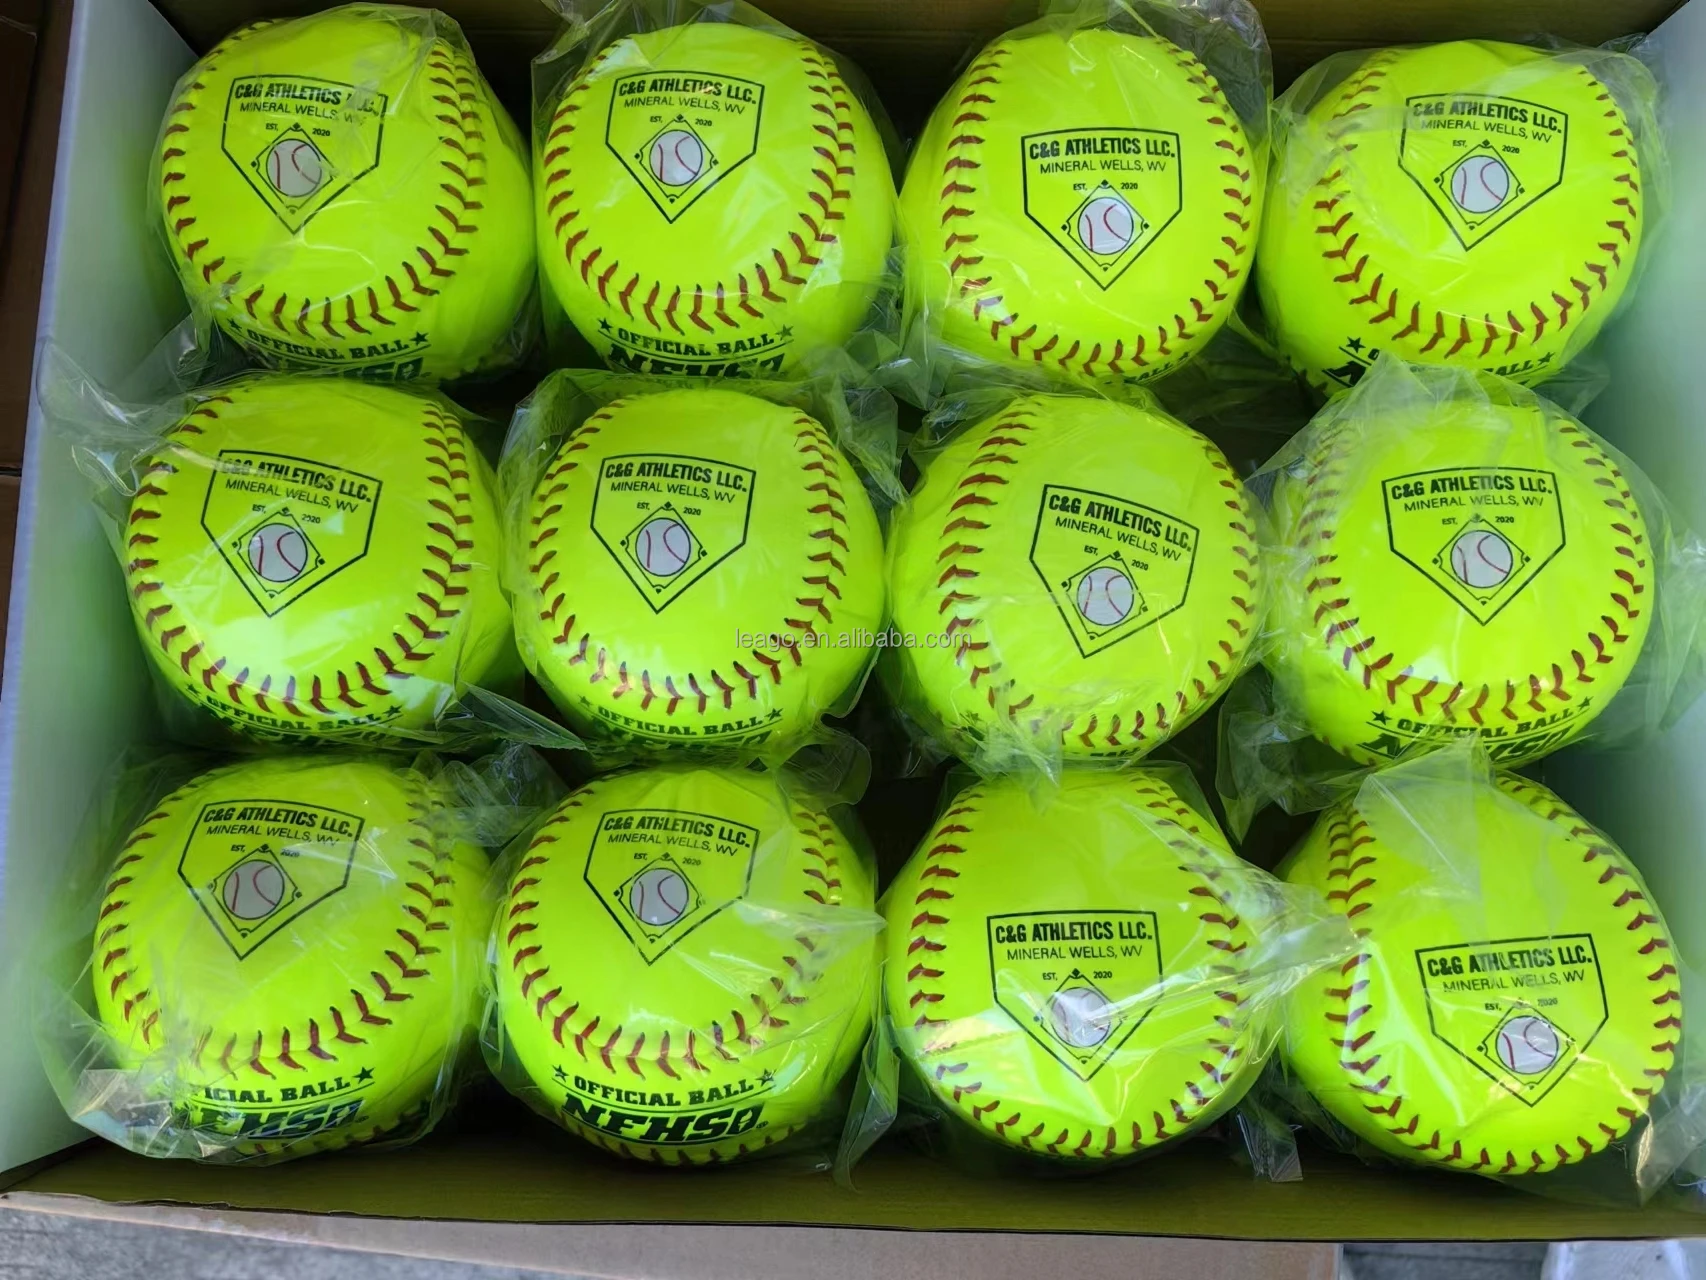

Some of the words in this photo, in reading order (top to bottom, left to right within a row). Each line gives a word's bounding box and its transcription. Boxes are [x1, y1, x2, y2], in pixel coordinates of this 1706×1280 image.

[235, 84, 263, 98] C&G
[265, 83, 341, 105] ATHLETICS
[619, 80, 646, 96] C&G
[649, 79, 722, 96] ATHLETICS
[727, 85, 757, 104] LLC.
[240, 102, 290, 114] MINERAL
[295, 105, 339, 120] WELLS
[624, 96, 675, 108] MINERAL
[679, 97, 721, 112] WELLS,
[725, 103, 745, 115] WV
[695, 119, 713, 127] 2020
[1413, 102, 1446, 117] C&G
[1449, 101, 1528, 123] ATHLETICS
[1533, 111, 1562, 134] LLC.
[312, 128, 331, 136] 2020
[1421, 119, 1480, 131] MINERAL
[1484, 121, 1528, 140] WELLS,
[1532, 129, 1552, 143] WV
[1030, 140, 1060, 160] C&G
[1065, 138, 1141, 156] ATHLETICS
[1146, 139, 1175, 158] LLC.
[1502, 145, 1520, 154] 2020
[1040, 160, 1097, 174] MINERAL
[1100, 159, 1144, 172] WELLS,
[1147, 161, 1167, 172] WV
[1121, 182, 1138, 190] 2020
[348, 339, 410, 359] BALL
[618, 328, 711, 356] OFFICIAL
[716, 333, 775, 354] BALL
[606, 462, 634, 478] C&G
[636, 462, 712, 483] ATHLETICS
[716, 471, 747, 492] LLC.
[1391, 481, 1425, 500] C&G
[1430, 475, 1515, 494] ATHLETICS
[1519, 476, 1553, 494] LLC.
[225, 479, 282, 497] MINERAL
[286, 488, 331, 509] WELLS,
[336, 499, 359, 513] WV
[339, 479, 372, 503] LLC.
[610, 481, 663, 492] MINERAL
[666, 484, 710, 500] WELLS,
[714, 490, 736, 504] WV
[683, 507, 701, 515] 2020
[1404, 497, 1467, 512] MINERAL
[1470, 494, 1519, 507] WELLS,
[1523, 496, 1544, 506] WV
[301, 514, 320, 524] 2020
[1049, 494, 1082, 515] C&G
[1084, 501, 1162, 538] ATHLETICS
[1165, 524, 1192, 552] LLC.
[1055, 516, 1113, 540] MINERAL
[1117, 530, 1159, 556] WELLS,
[1162, 546, 1182, 561] WV
[1131, 559, 1149, 571] 2020
[598, 706, 697, 735] OFFICIAL
[703, 716, 763, 735] BALL
[1397, 718, 1508, 738] OFFICIAL
[1515, 709, 1573, 734] BALL
[203, 807, 236, 823] C&G
[236, 807, 318, 828] ATHLETICS
[320, 816, 353, 837] LLC.
[604, 816, 634, 831] C&G
[635, 816, 714, 837] ATHLETICS
[718, 826, 750, 848] LLC.
[206, 825, 262, 835] MINERAL
[266, 826, 312, 843] WELLS,
[608, 833, 662, 844] MINERAL
[666, 836, 711, 852] WELLS,
[715, 843, 738, 856] WV
[682, 857, 701, 865] 2020
[995, 924, 1027, 944] C&G
[1032, 921, 1114, 942] ATHLETICS
[1118, 921, 1153, 940] LLC.
[1007, 946, 1066, 961] MINERAL
[1069, 945, 1117, 959] WELLS,
[1120, 945, 1143, 957] WV
[1427, 956, 1464, 977] C&G
[1469, 948, 1555, 973] ATHLETICS
[1557, 945, 1593, 966] LLC.
[1093, 971, 1113, 979] 2020
[1442, 976, 1508, 993] MINERAL
[1511, 972, 1562, 988] WELLS,
[1563, 969, 1585, 983] WV
[205, 1087, 272, 1102] ICIAL
[280, 1076, 351, 1102] BALL
[574, 1076, 681, 1106] OFFICIAL
[688, 1079, 754, 1105] BALL
